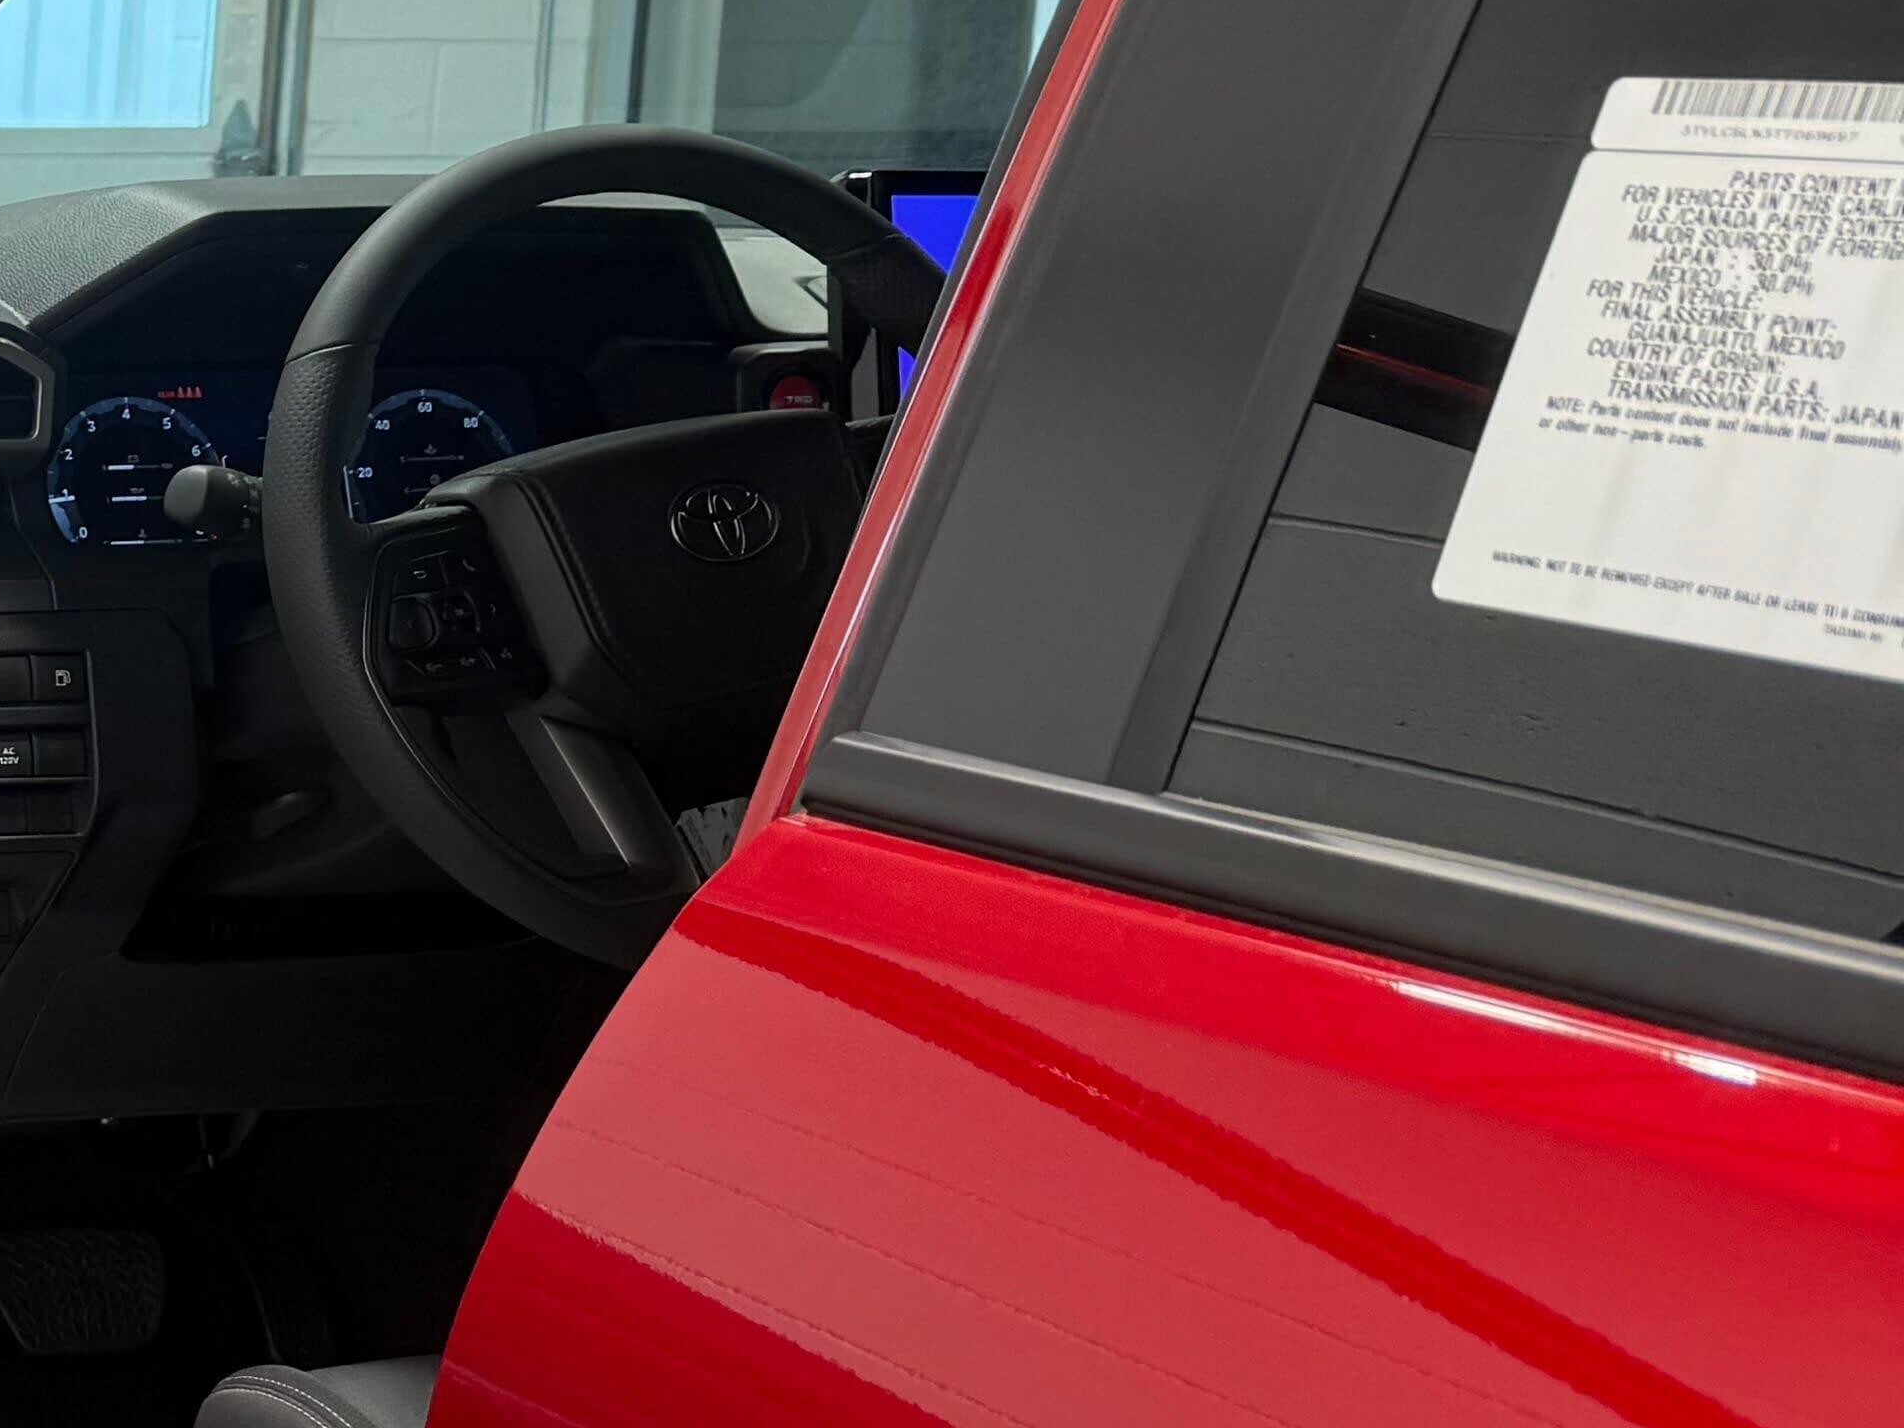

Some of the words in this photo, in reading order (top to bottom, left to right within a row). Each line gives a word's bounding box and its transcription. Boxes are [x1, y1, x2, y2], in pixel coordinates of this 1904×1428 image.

[1729, 171, 1796, 192] PARTS
[1799, 174, 1896, 197] CONTENT
[1621, 184, 1660, 205] FOR
[1665, 186, 1755, 209] VEHICLES
[1759, 191, 1785, 211] IN
[1791, 193, 1833, 214] THIS
[1763, 213, 1830, 235] PARTS
[1628, 224, 1693, 245] MAJOR
[1700, 229, 1791, 253] SOURCES
[1795, 235, 1824, 255] OF
[1655, 245, 1719, 266] JAPAN
[1647, 265, 1722, 288] MEXICO
[1586, 278, 1624, 300] FOR
[1630, 281, 1672, 303] THIS
[1678, 287, 1764, 311] VEHICLE:
[1600, 300, 1654, 322] FINAL
[1659, 306, 1766, 332] ASSEMBLY
[1587, 338, 1676, 363] COUNTRY
[1679, 346, 1708, 367] OF
[1766, 335, 1847, 360] MEXICO
[1613, 361, 1684, 385] ENGINE
[1686, 368, 1758, 393] PARTS:
[417, 402, 433, 413] 60
[1546, 396, 1585, 415] NOTE:
[1608, 379, 1752, 413] TRANSMISSION
[1754, 396, 1830, 422] PARTS:
[121, 409, 131, 419] 4
[162, 417, 172, 429] 5
[463, 417, 479, 429] 80
[87, 420, 96, 433] 3
[375, 420, 391, 431] 40
[64, 449, 73, 461] 2
[191, 445, 201, 457] 6
[357, 467, 373, 478] 20
[79, 527, 88, 539] 0
